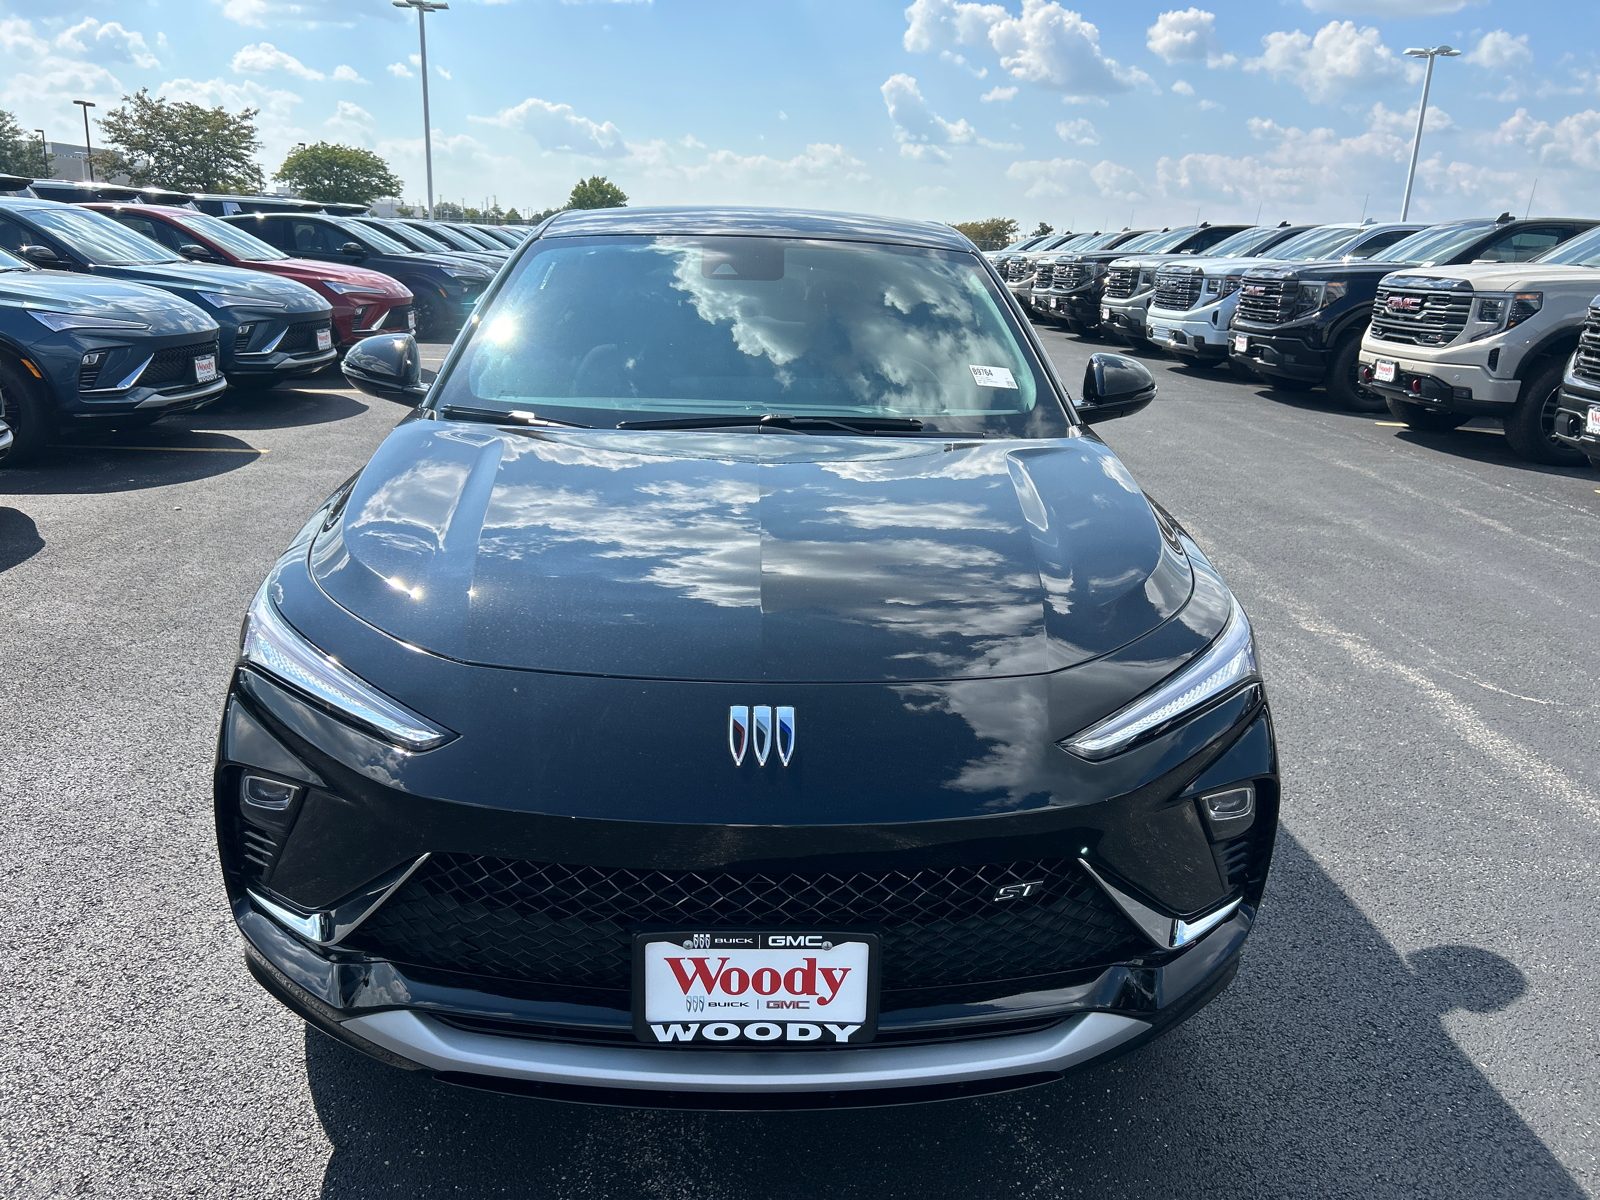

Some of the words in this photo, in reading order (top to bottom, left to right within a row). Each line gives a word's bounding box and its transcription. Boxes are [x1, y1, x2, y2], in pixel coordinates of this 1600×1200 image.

[1387, 296, 1422, 310] GMC
[196, 361, 213, 371] Woody
[994, 880, 1043, 901] ST
[768, 936, 822, 946] GMC
[664, 957, 851, 1006] Woody
[766, 1000, 810, 1009] GMC
[651, 1023, 861, 1043] WOODY
